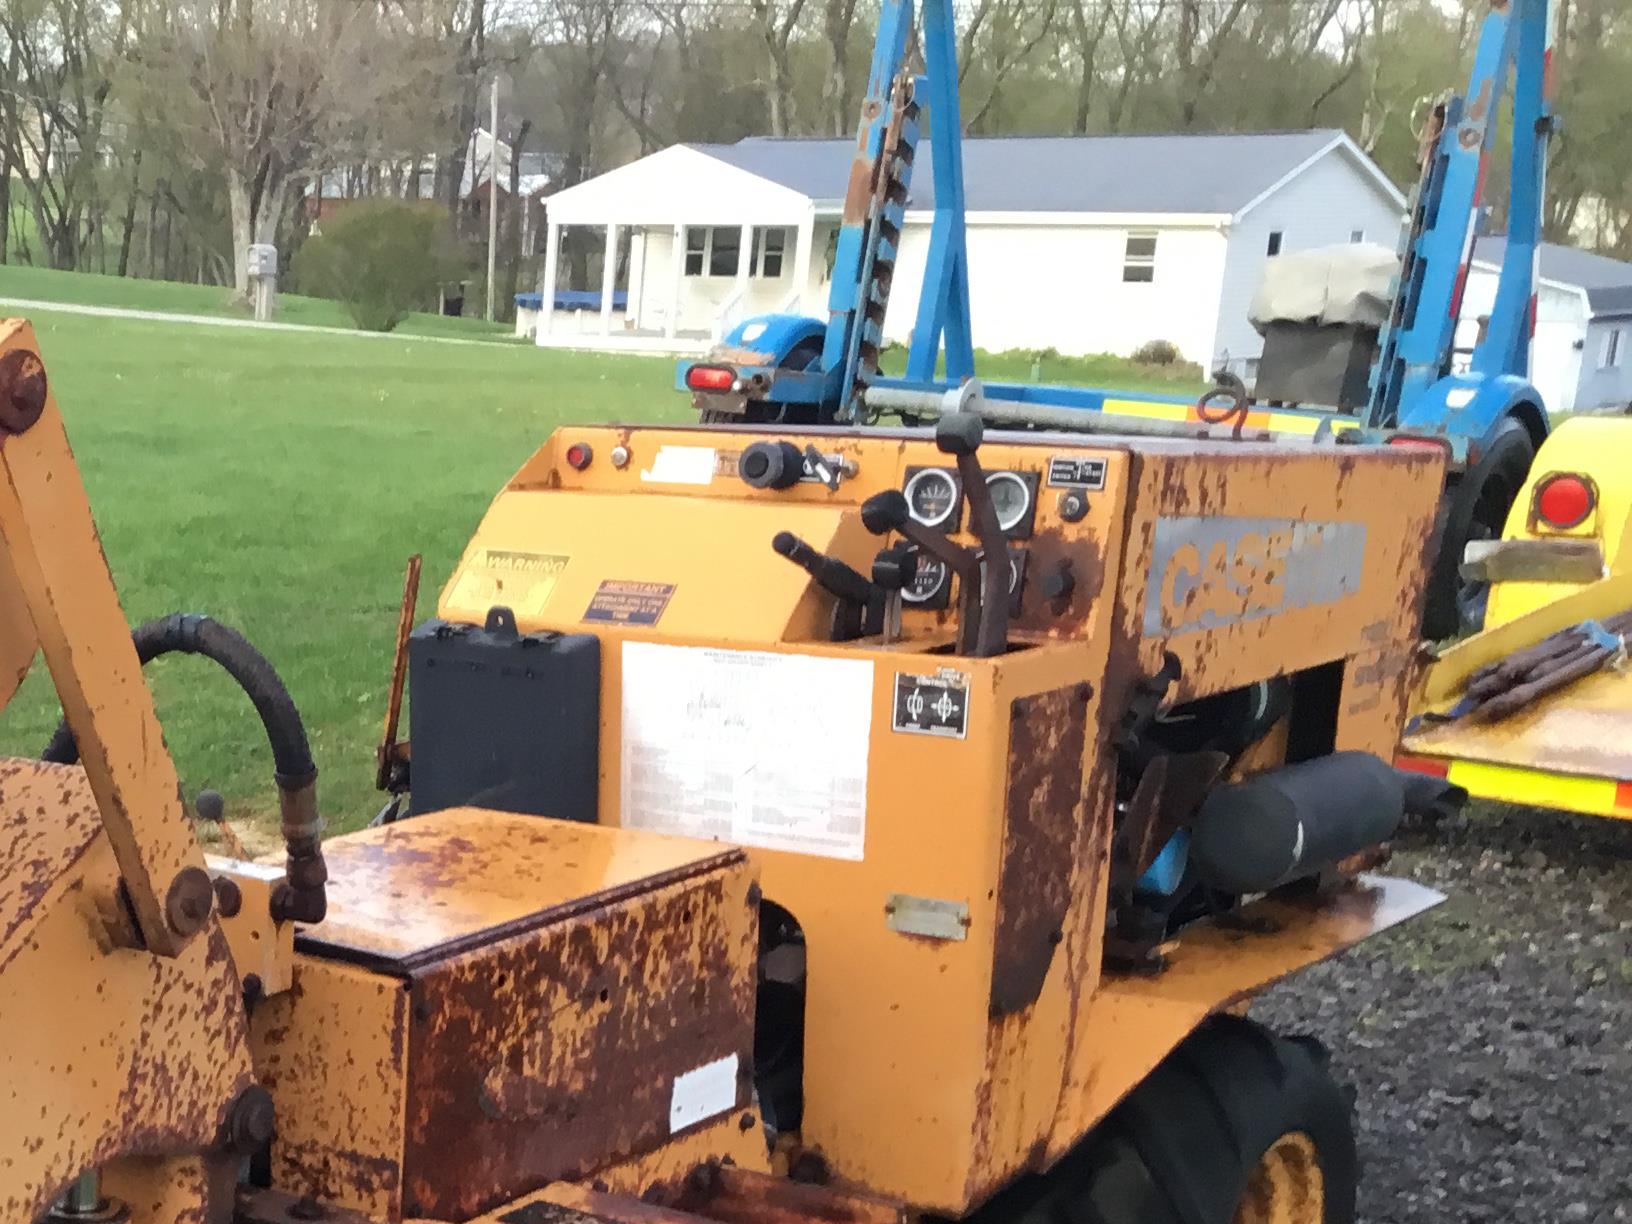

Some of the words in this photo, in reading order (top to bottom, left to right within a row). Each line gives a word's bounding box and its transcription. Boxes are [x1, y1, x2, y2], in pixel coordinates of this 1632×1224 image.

[487, 556, 566, 573] WARNING
[605, 582, 667, 594] IMPORTANT
[1160, 531, 1294, 628] CASE
